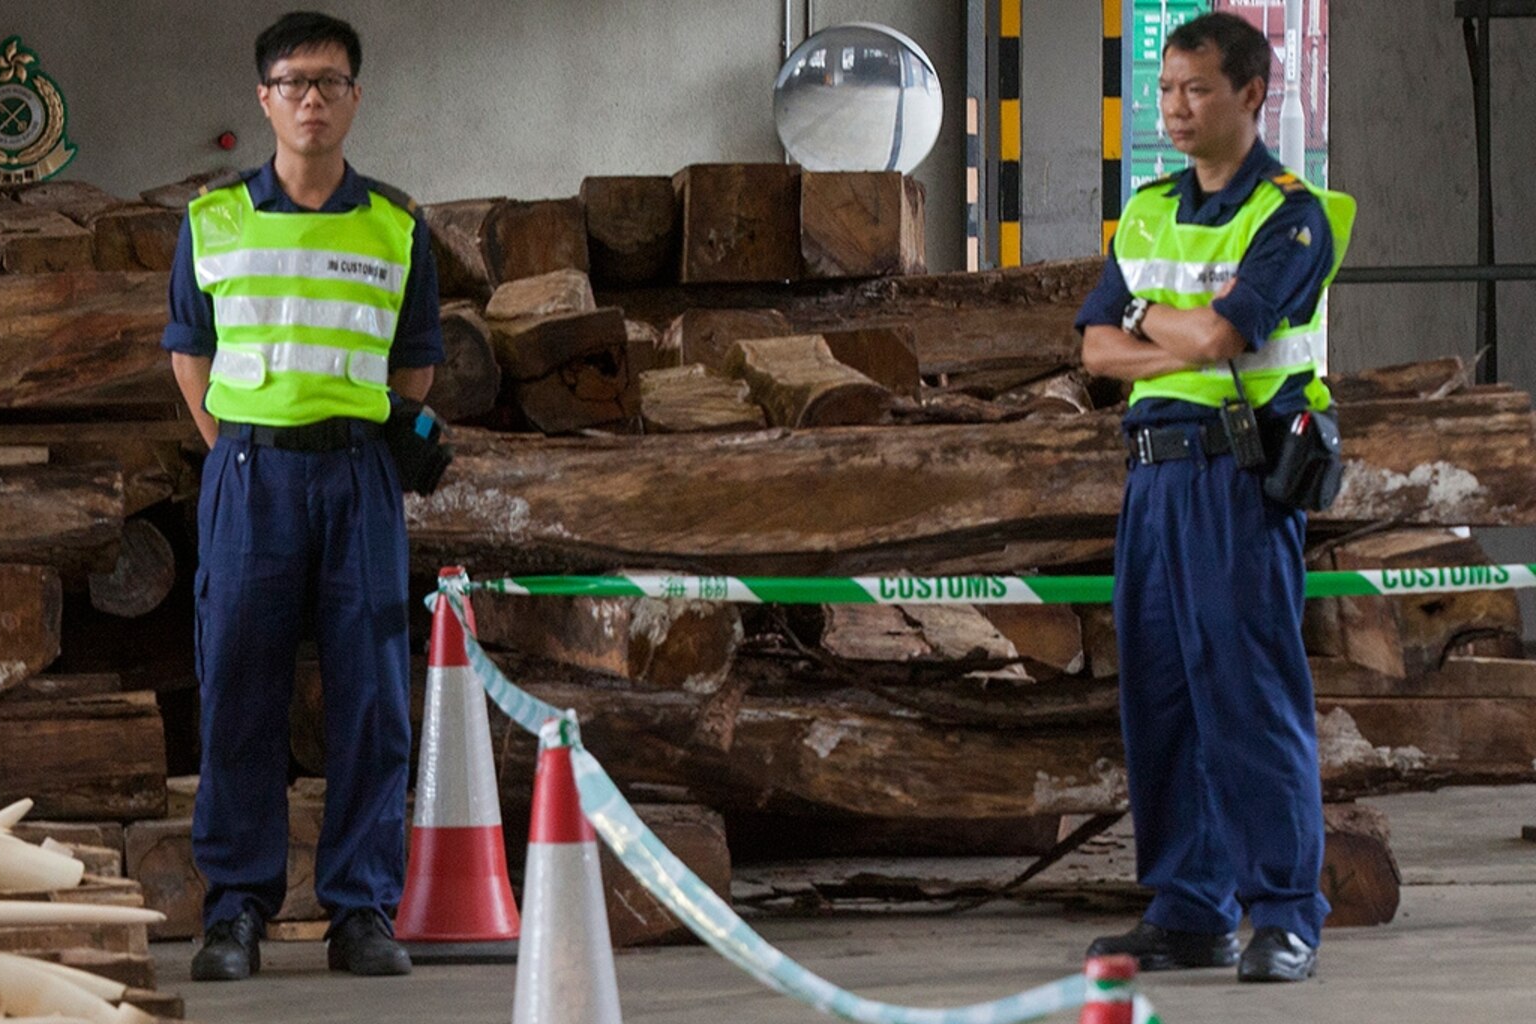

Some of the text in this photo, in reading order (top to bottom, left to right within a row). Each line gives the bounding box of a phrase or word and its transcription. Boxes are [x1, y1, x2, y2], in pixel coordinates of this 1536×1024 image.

[340, 260, 379, 277] CUSTOMS
[879, 576, 1007, 599] CUSTOMS
[1382, 566, 1509, 588] CUSTOMS
